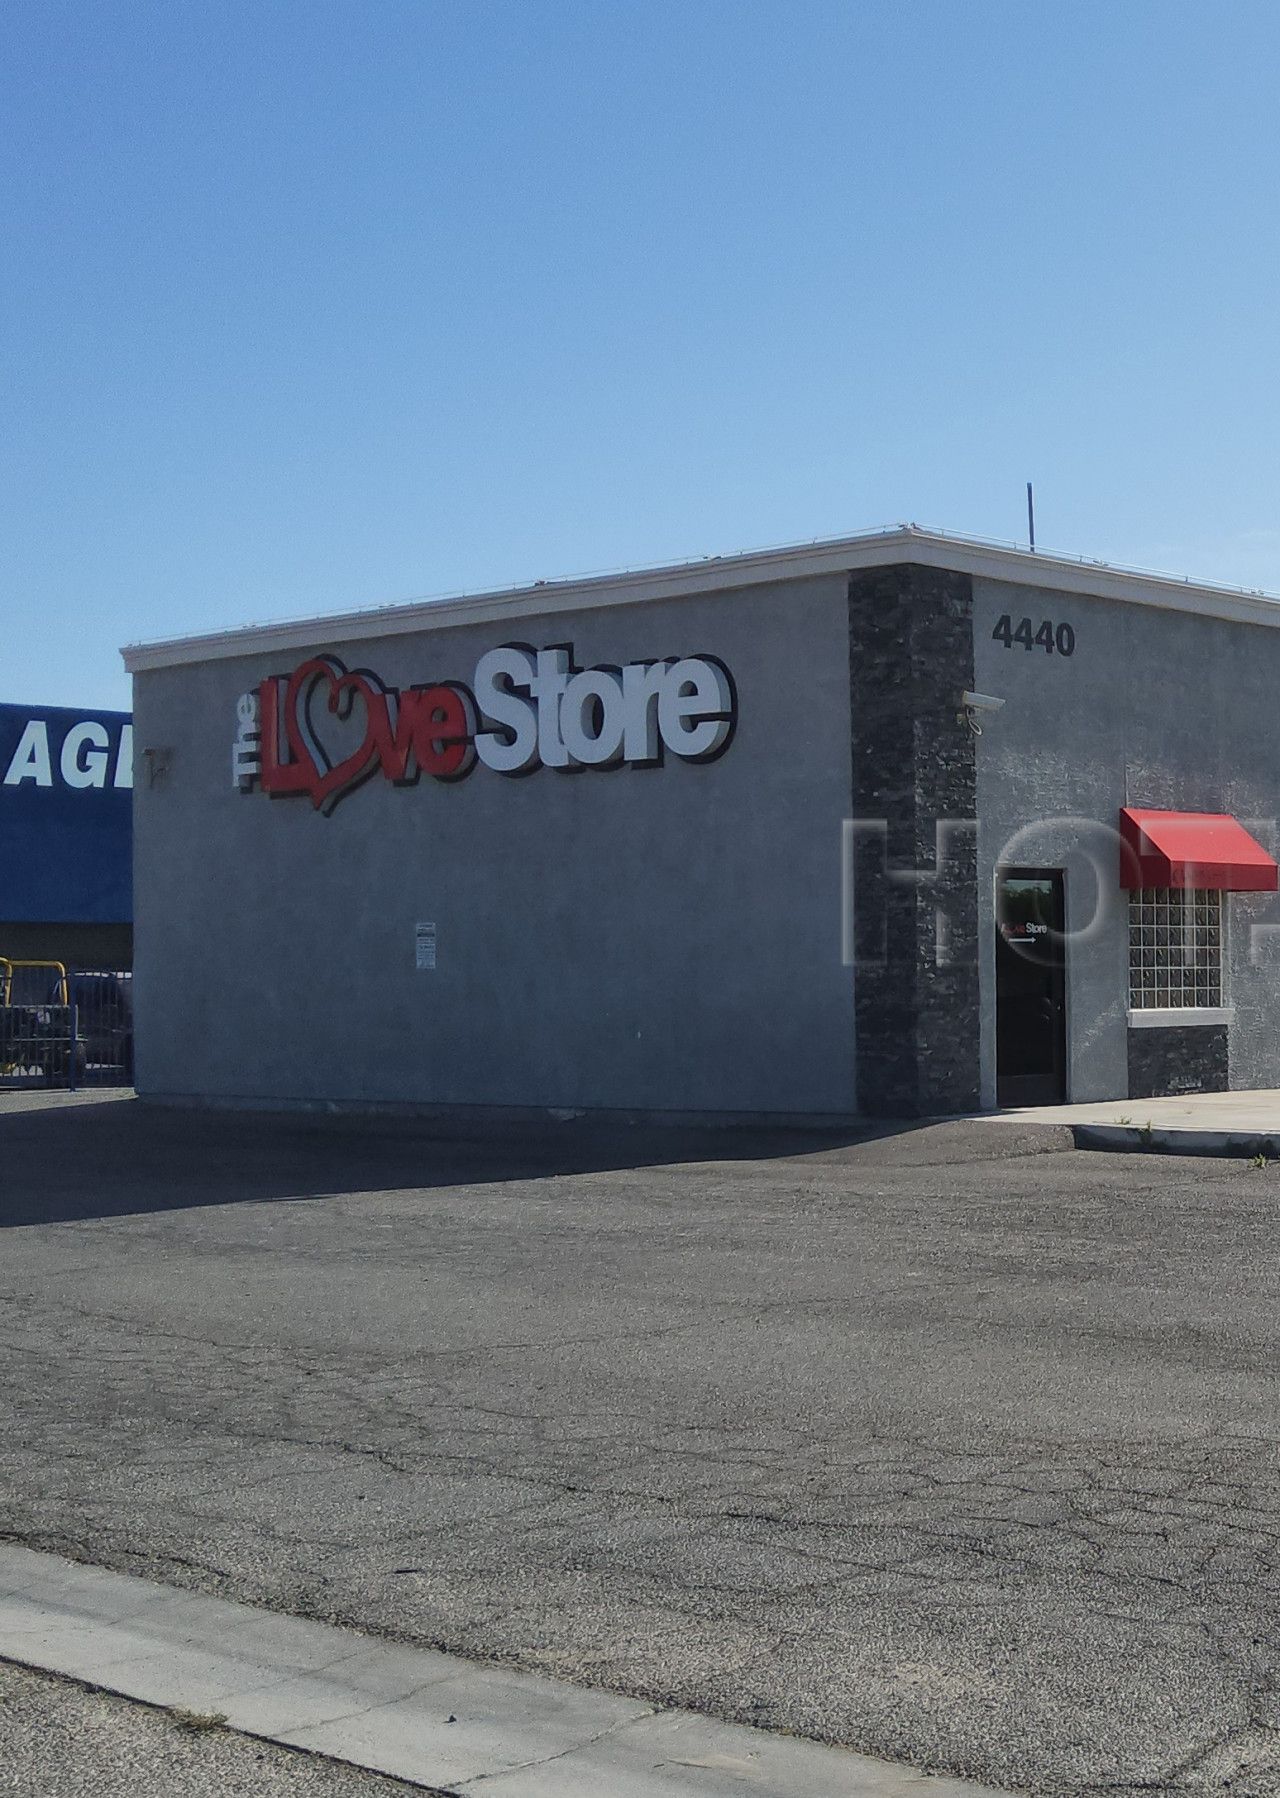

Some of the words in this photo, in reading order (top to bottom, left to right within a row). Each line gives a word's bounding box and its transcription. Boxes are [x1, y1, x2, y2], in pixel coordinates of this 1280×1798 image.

[992, 614, 1075, 657] 4440
[233, 693, 258, 787] The
[474, 647, 733, 772] Store
